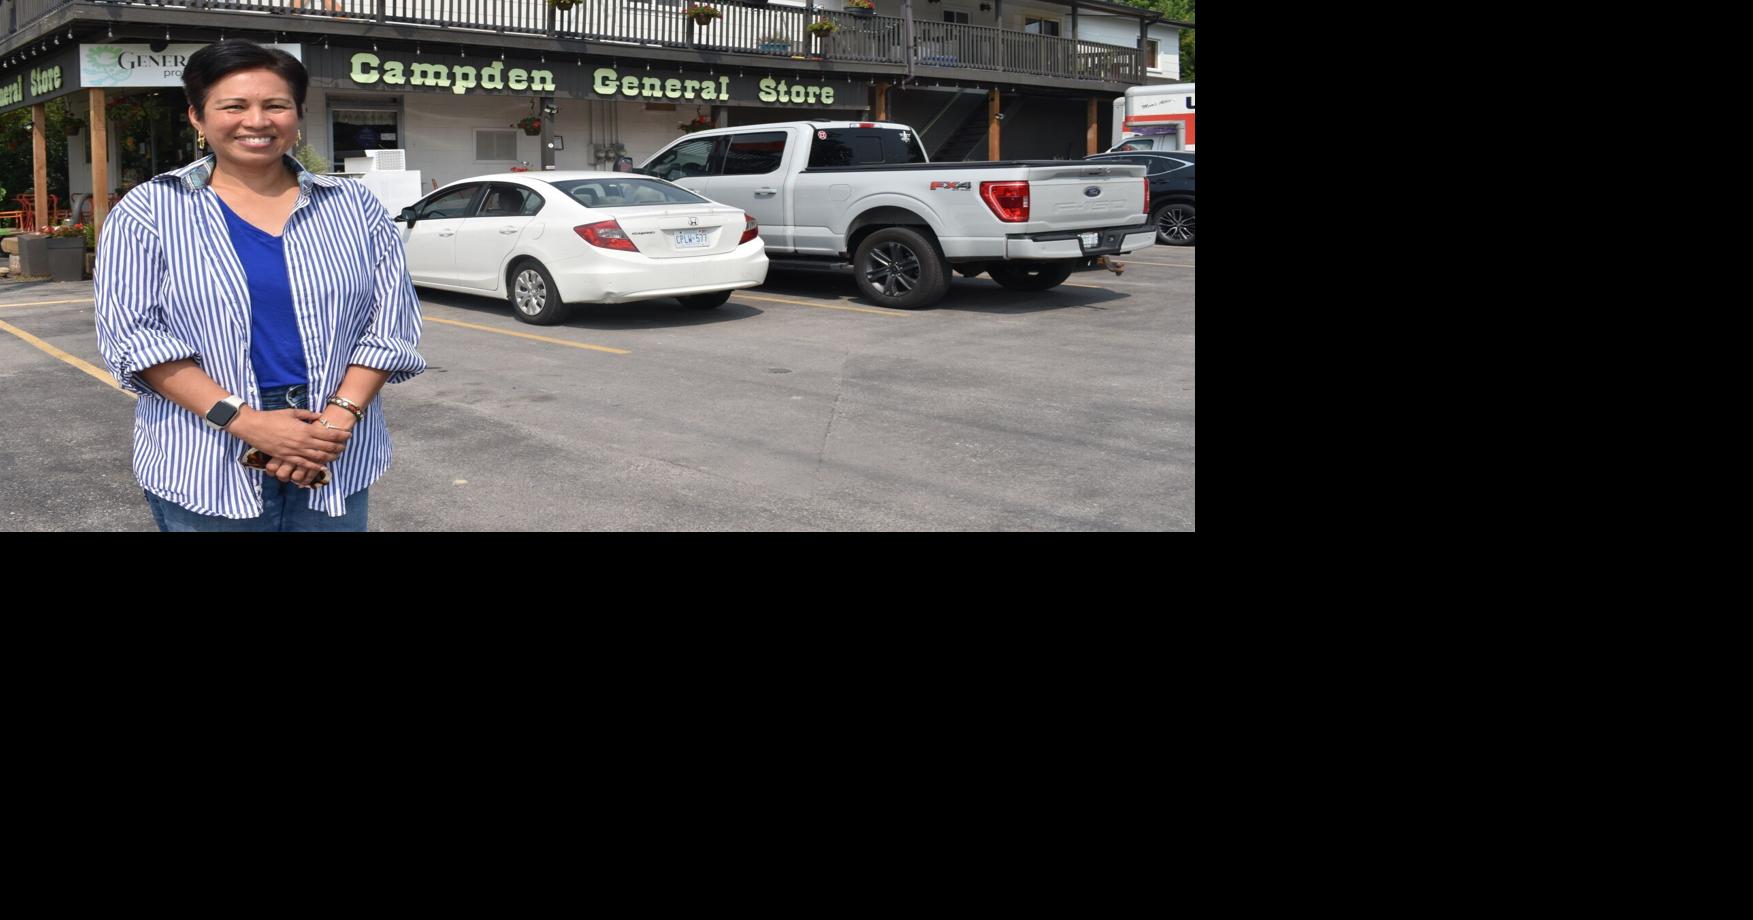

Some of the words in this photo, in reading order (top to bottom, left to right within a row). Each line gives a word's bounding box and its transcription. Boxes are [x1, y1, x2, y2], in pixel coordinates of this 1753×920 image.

[118, 52, 187, 70] GENER
[31, 65, 61, 96] Store
[350, 52, 556, 95] Campden
[593, 68, 730, 101] General
[759, 77, 834, 104] Store
[930, 181, 971, 190] FX4
